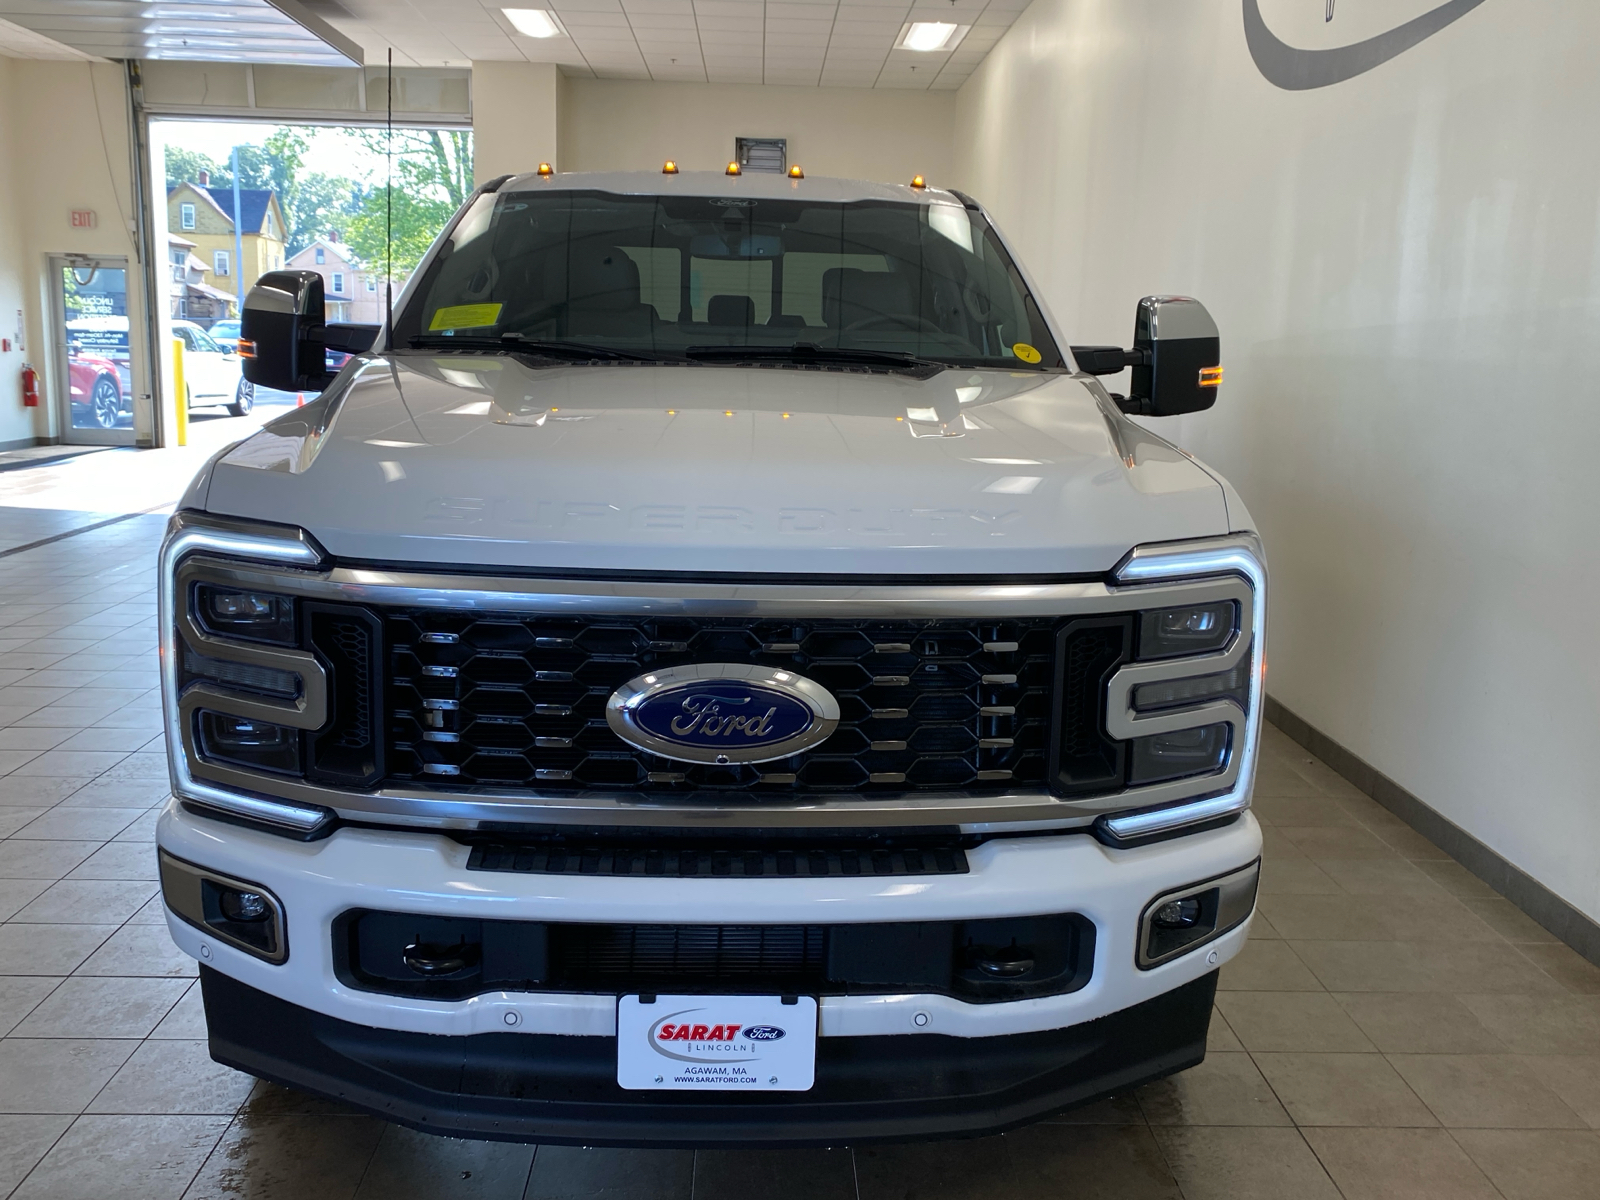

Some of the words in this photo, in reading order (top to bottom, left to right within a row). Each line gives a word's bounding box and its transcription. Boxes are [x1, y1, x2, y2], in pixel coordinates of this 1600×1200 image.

[71, 211, 92, 227] EXIT
[422, 496, 755, 532] SUPER
[777, 505, 1021, 535] DUTY
[670, 693, 777, 737] Ford
[657, 1024, 743, 1041] SARAT
[749, 1026, 778, 1039] Ford
[684, 1067, 730, 1076] AGAWAM,
[732, 1067, 747, 1075] MA
